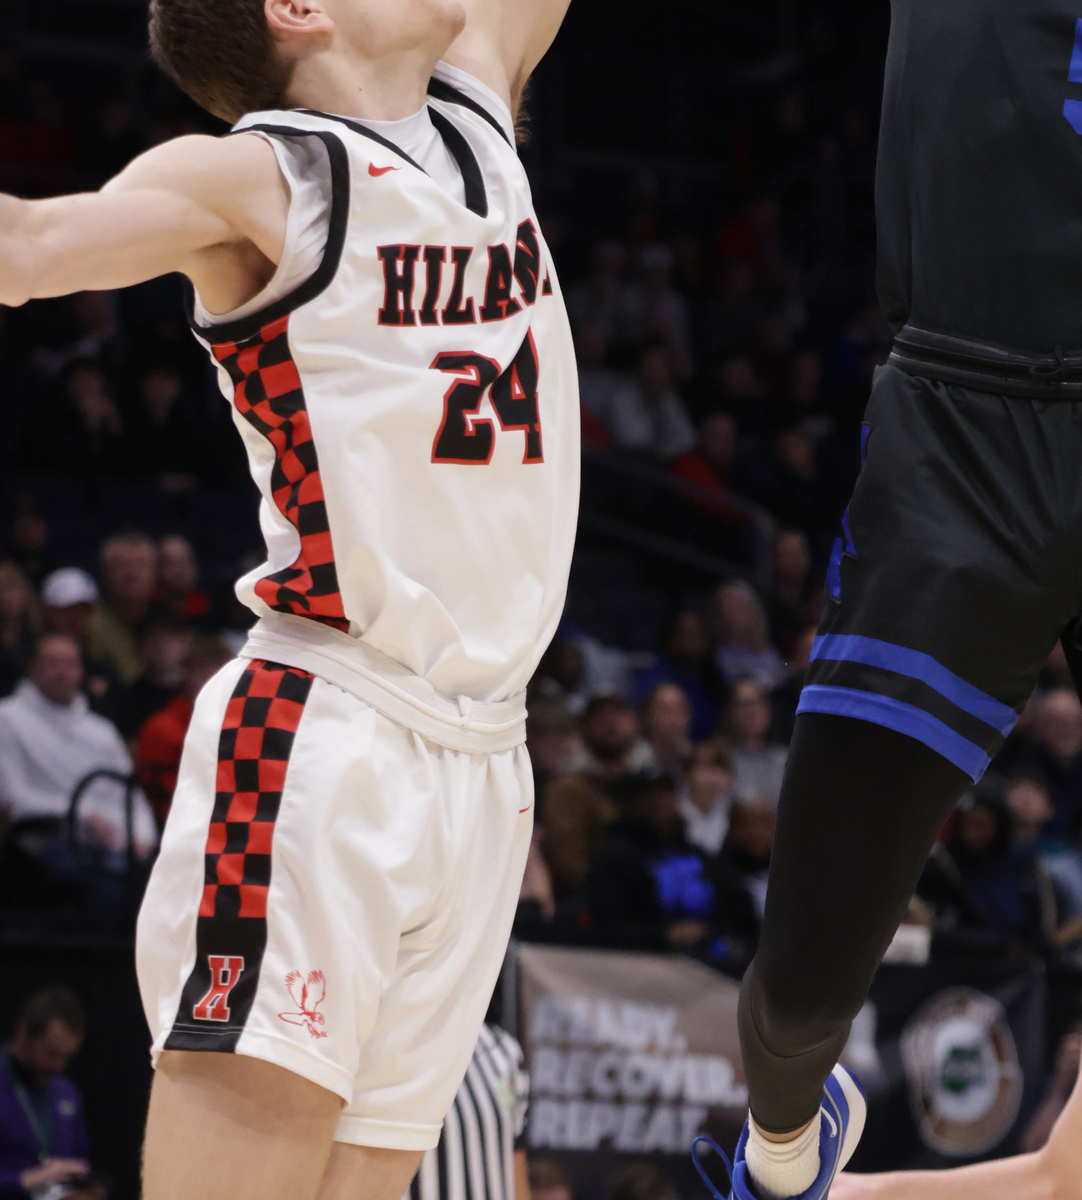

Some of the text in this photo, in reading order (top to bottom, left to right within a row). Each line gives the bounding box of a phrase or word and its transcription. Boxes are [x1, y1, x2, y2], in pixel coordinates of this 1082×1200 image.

[376, 217, 553, 327] HILAN
[429, 325, 545, 465] 24
[193, 955, 245, 1022] H
